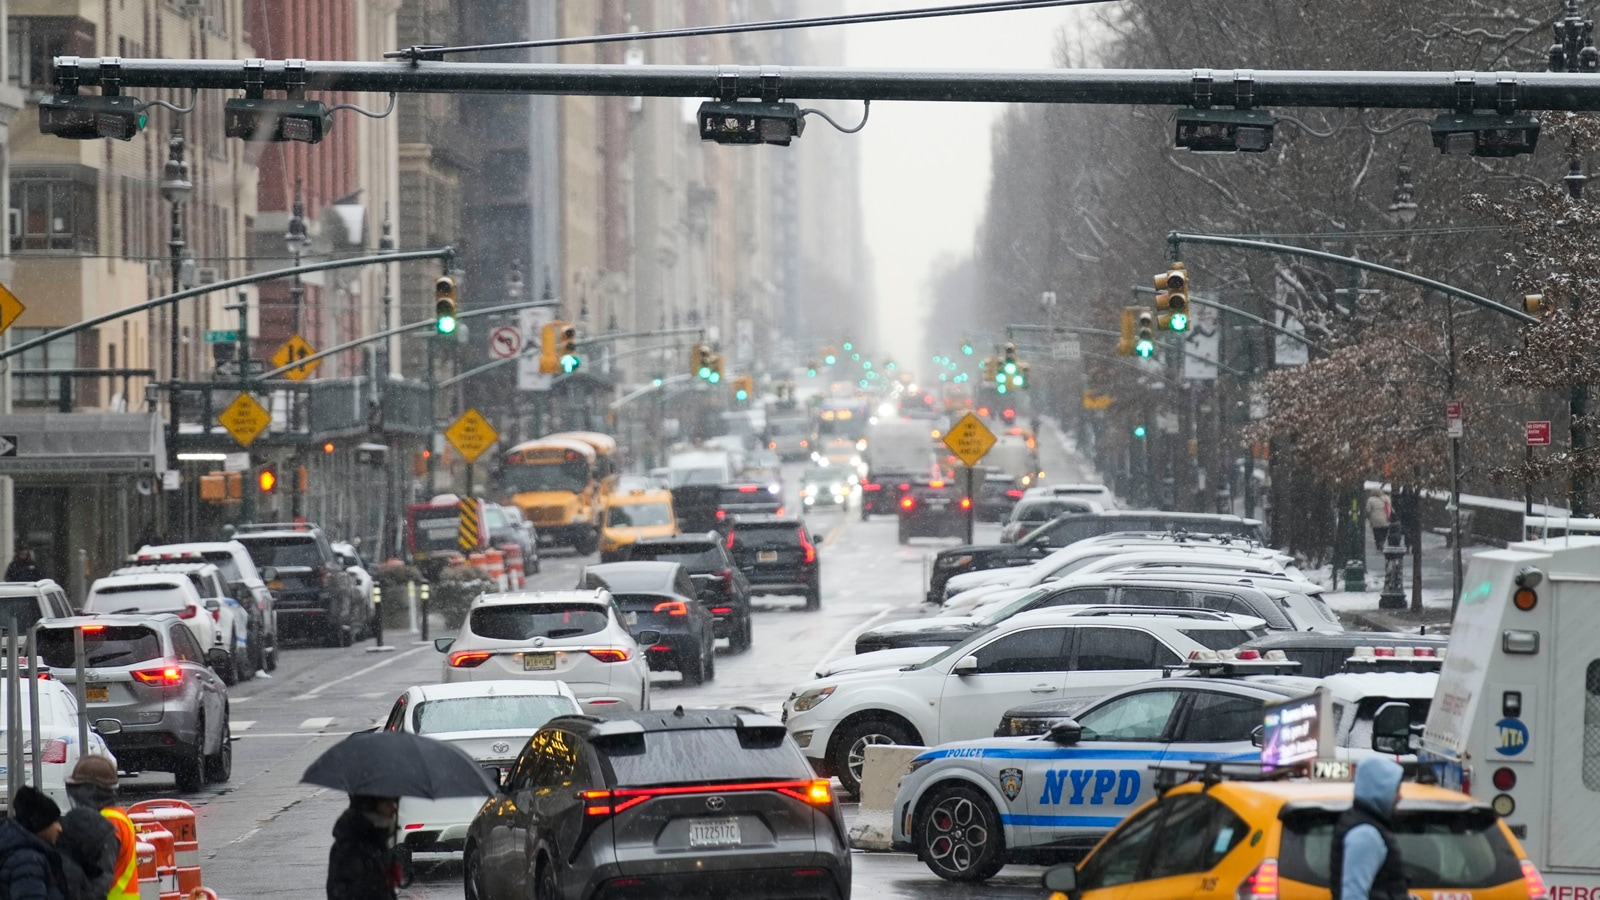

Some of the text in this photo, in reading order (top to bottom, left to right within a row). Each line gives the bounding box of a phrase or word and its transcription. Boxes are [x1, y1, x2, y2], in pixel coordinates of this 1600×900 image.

[947, 748, 983, 758] POLICE
[1039, 769, 1141, 805] NYPD
[694, 825, 735, 840] T122517C
